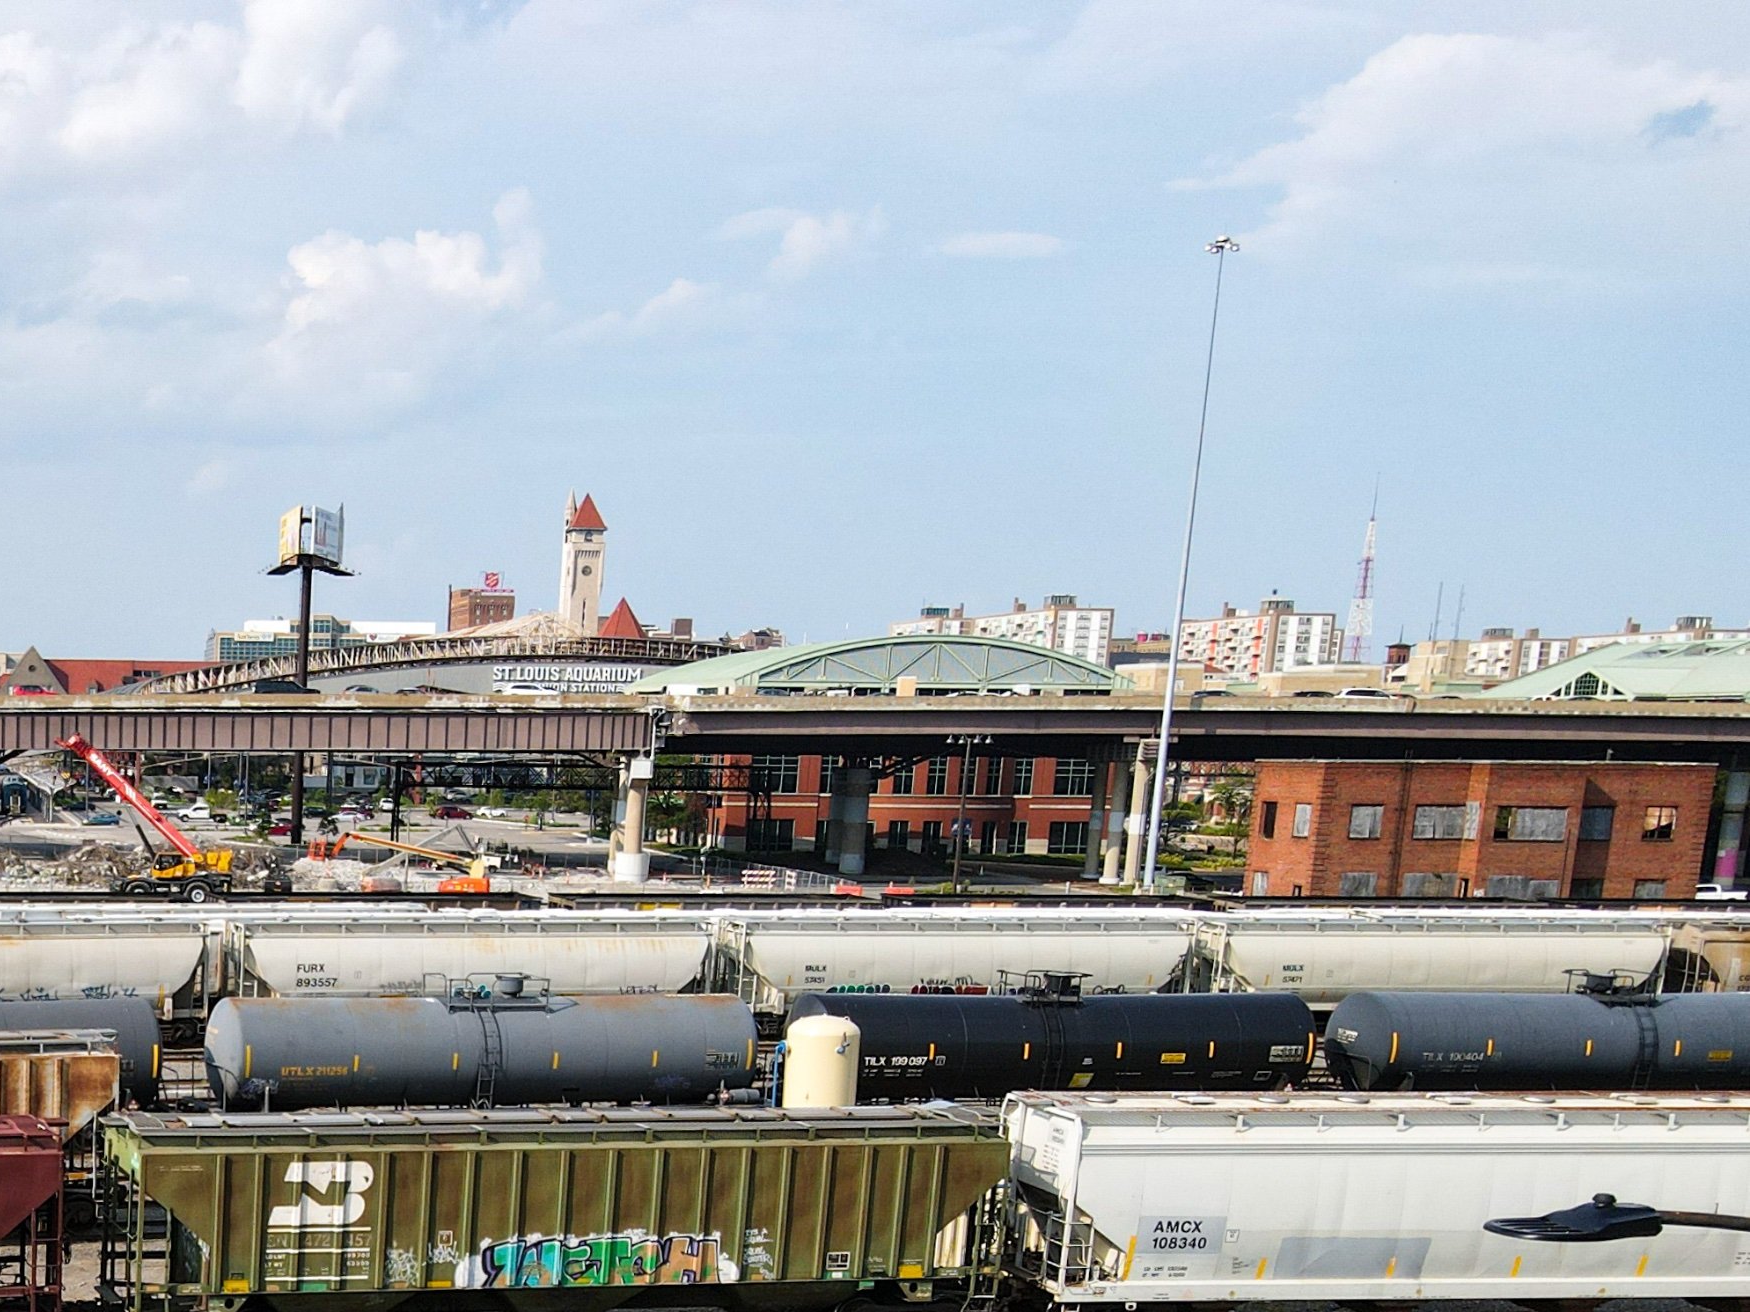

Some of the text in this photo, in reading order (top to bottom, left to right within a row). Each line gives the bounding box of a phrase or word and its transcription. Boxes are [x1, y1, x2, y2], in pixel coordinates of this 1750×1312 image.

[493, 666, 642, 682] ST. LOUIS AQUARIUM
[571, 682, 615, 693] STATION
[296, 963, 325, 973] FURX
[295, 977, 338, 988] 893557
[863, 1056, 887, 1066] TILX
[1152, 1220, 1203, 1234] AMCX
[1151, 1236, 1207, 1251] 108340
